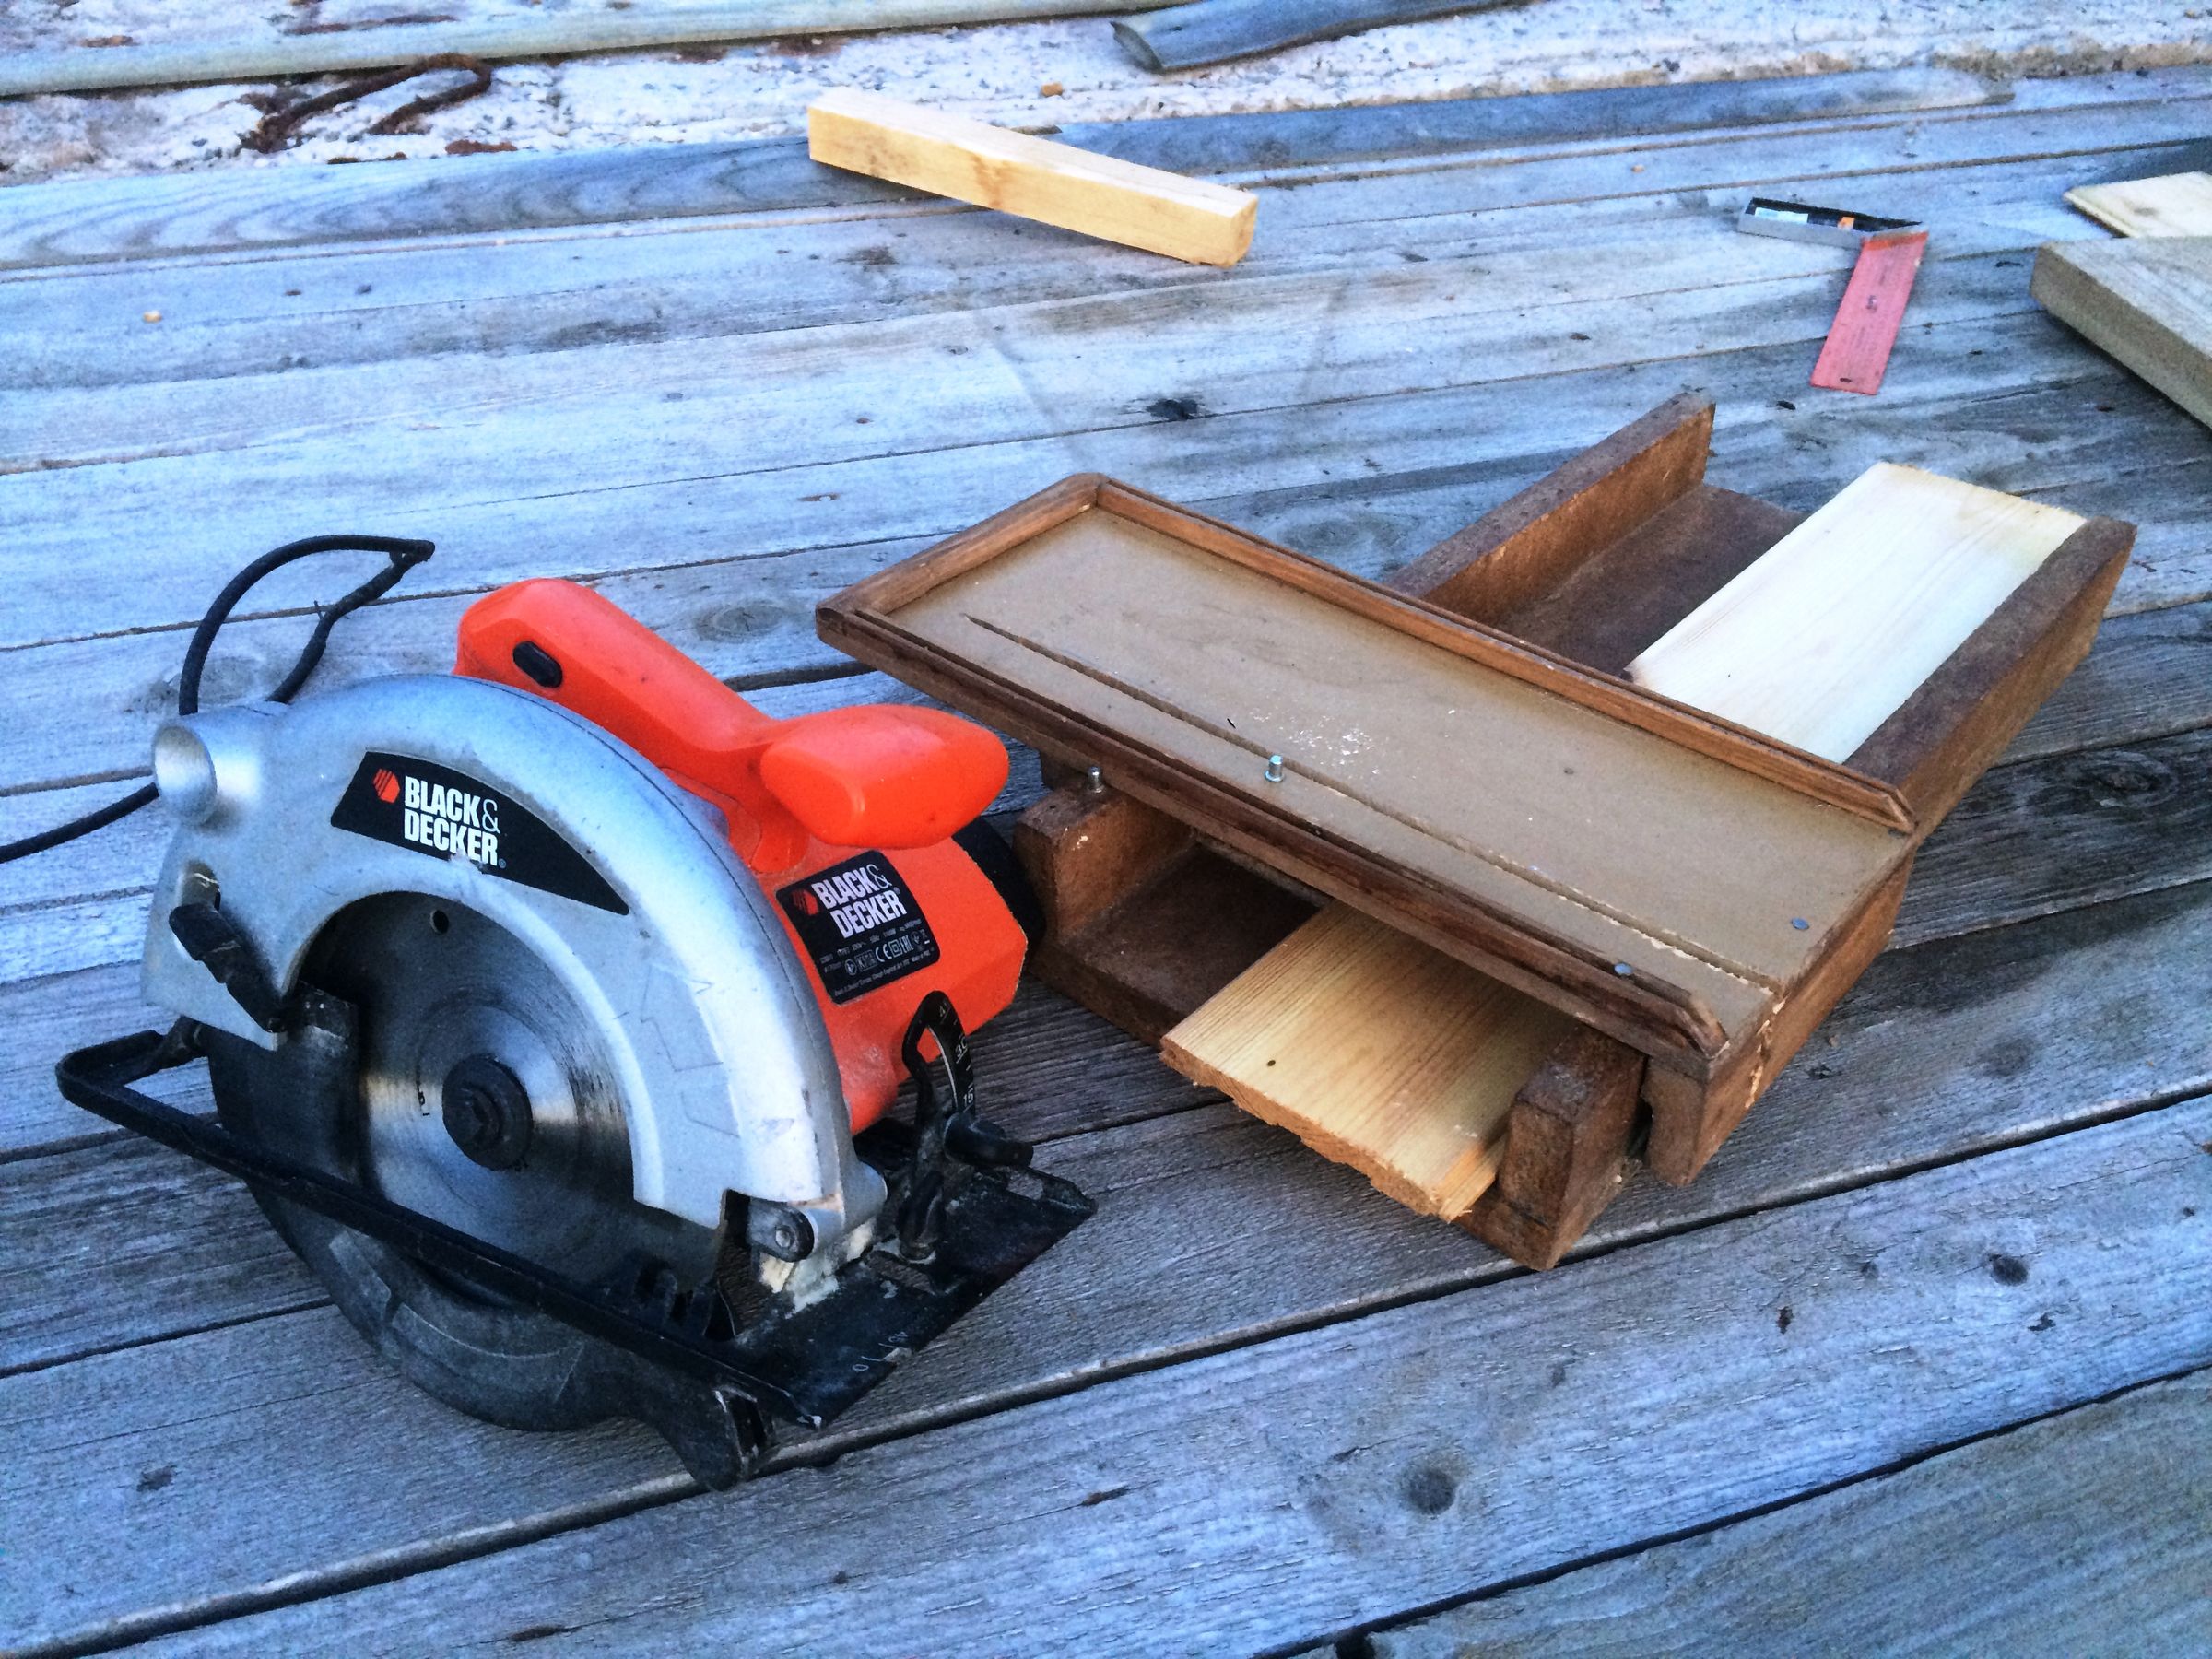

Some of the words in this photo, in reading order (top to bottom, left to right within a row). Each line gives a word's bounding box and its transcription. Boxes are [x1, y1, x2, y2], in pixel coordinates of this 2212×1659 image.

[404, 808, 499, 866] DECKER
[830, 889, 908, 939] DECKER
[963, 1087, 974, 1107] 15
